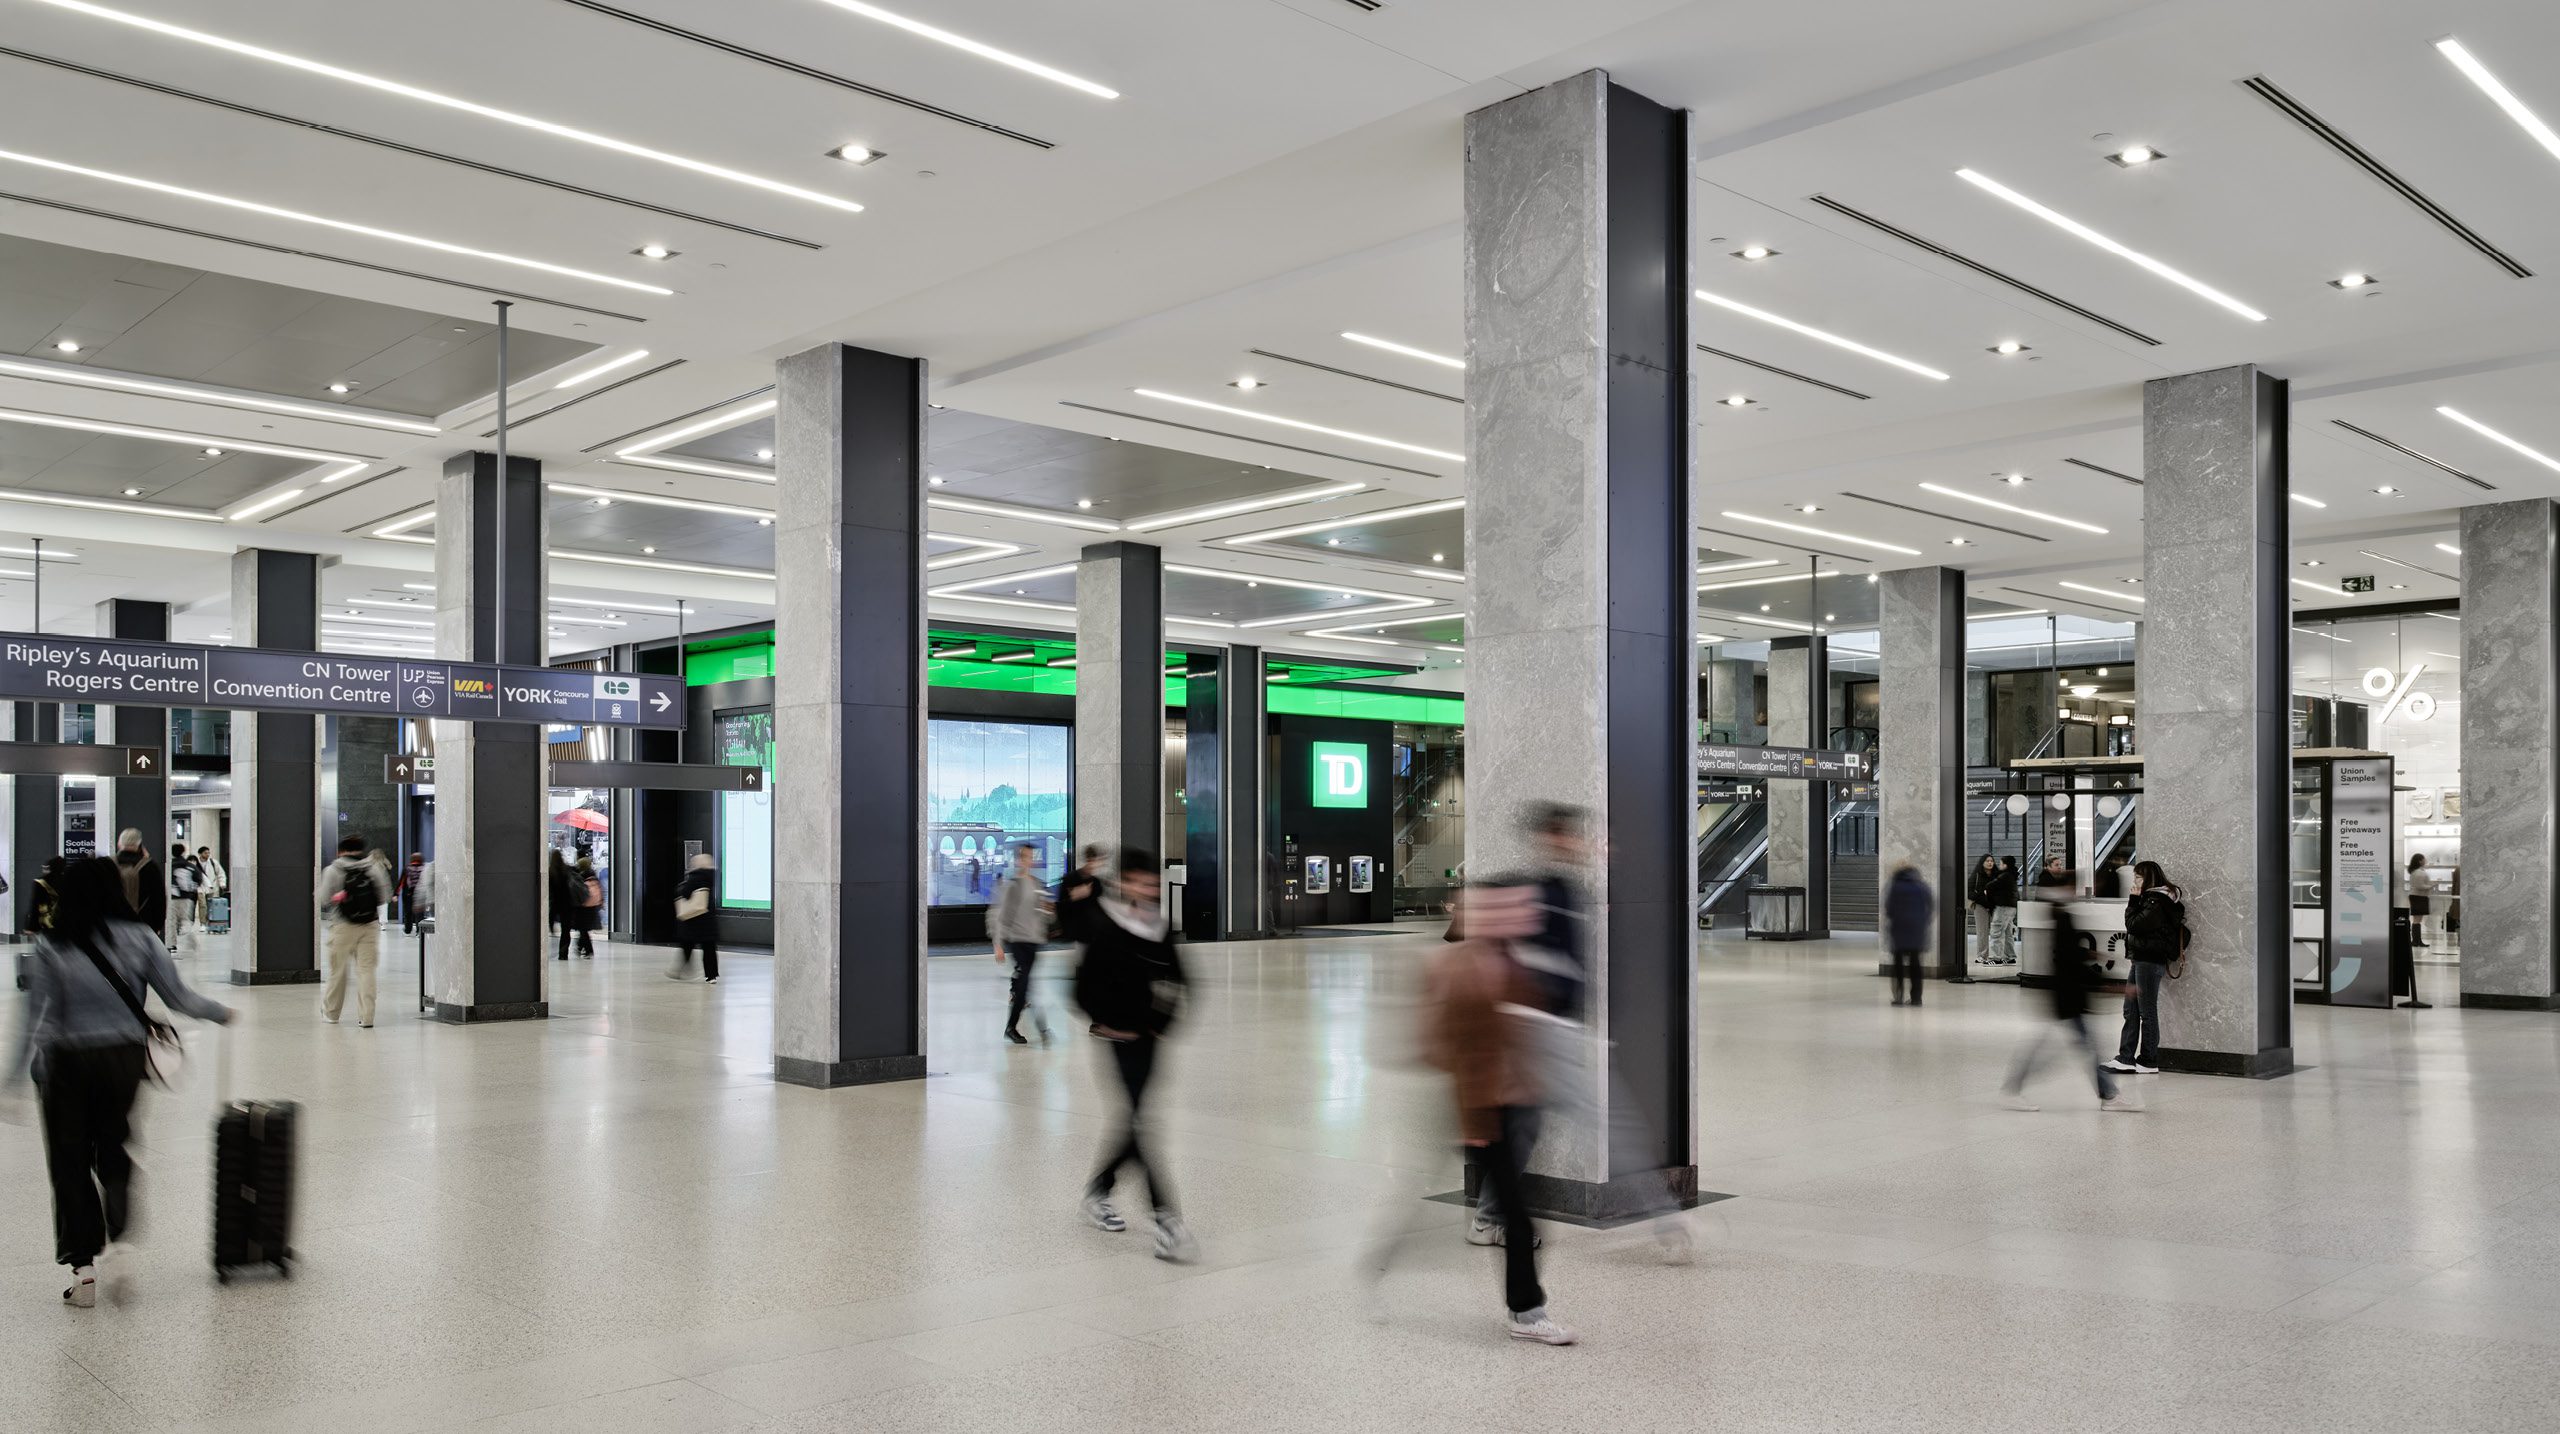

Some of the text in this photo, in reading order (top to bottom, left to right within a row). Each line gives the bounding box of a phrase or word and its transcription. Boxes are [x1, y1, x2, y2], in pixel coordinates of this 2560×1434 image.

[6, 643, 199, 671] Ripley's Aquarium
[302, 662, 391, 682] CN Tower
[403, 668, 425, 683] UP
[46, 670, 199, 694] Rogers Centre
[454, 680, 484, 692] VIA
[214, 679, 391, 704] Convention Centre
[504, 687, 552, 704] YORK
[553, 690, 590, 699] Concourse
[1708, 748, 1735, 759] Aquarium
[1762, 751, 1770, 760] CN
[1771, 752, 1787, 761] Tower
[1716, 760, 1735, 770] Centre
[1738, 760, 1787, 772] Convention Centre
[1818, 761, 1833, 770] YORK
[1320, 754, 1363, 795] TD
[2340, 826, 2381, 834] giveaways
